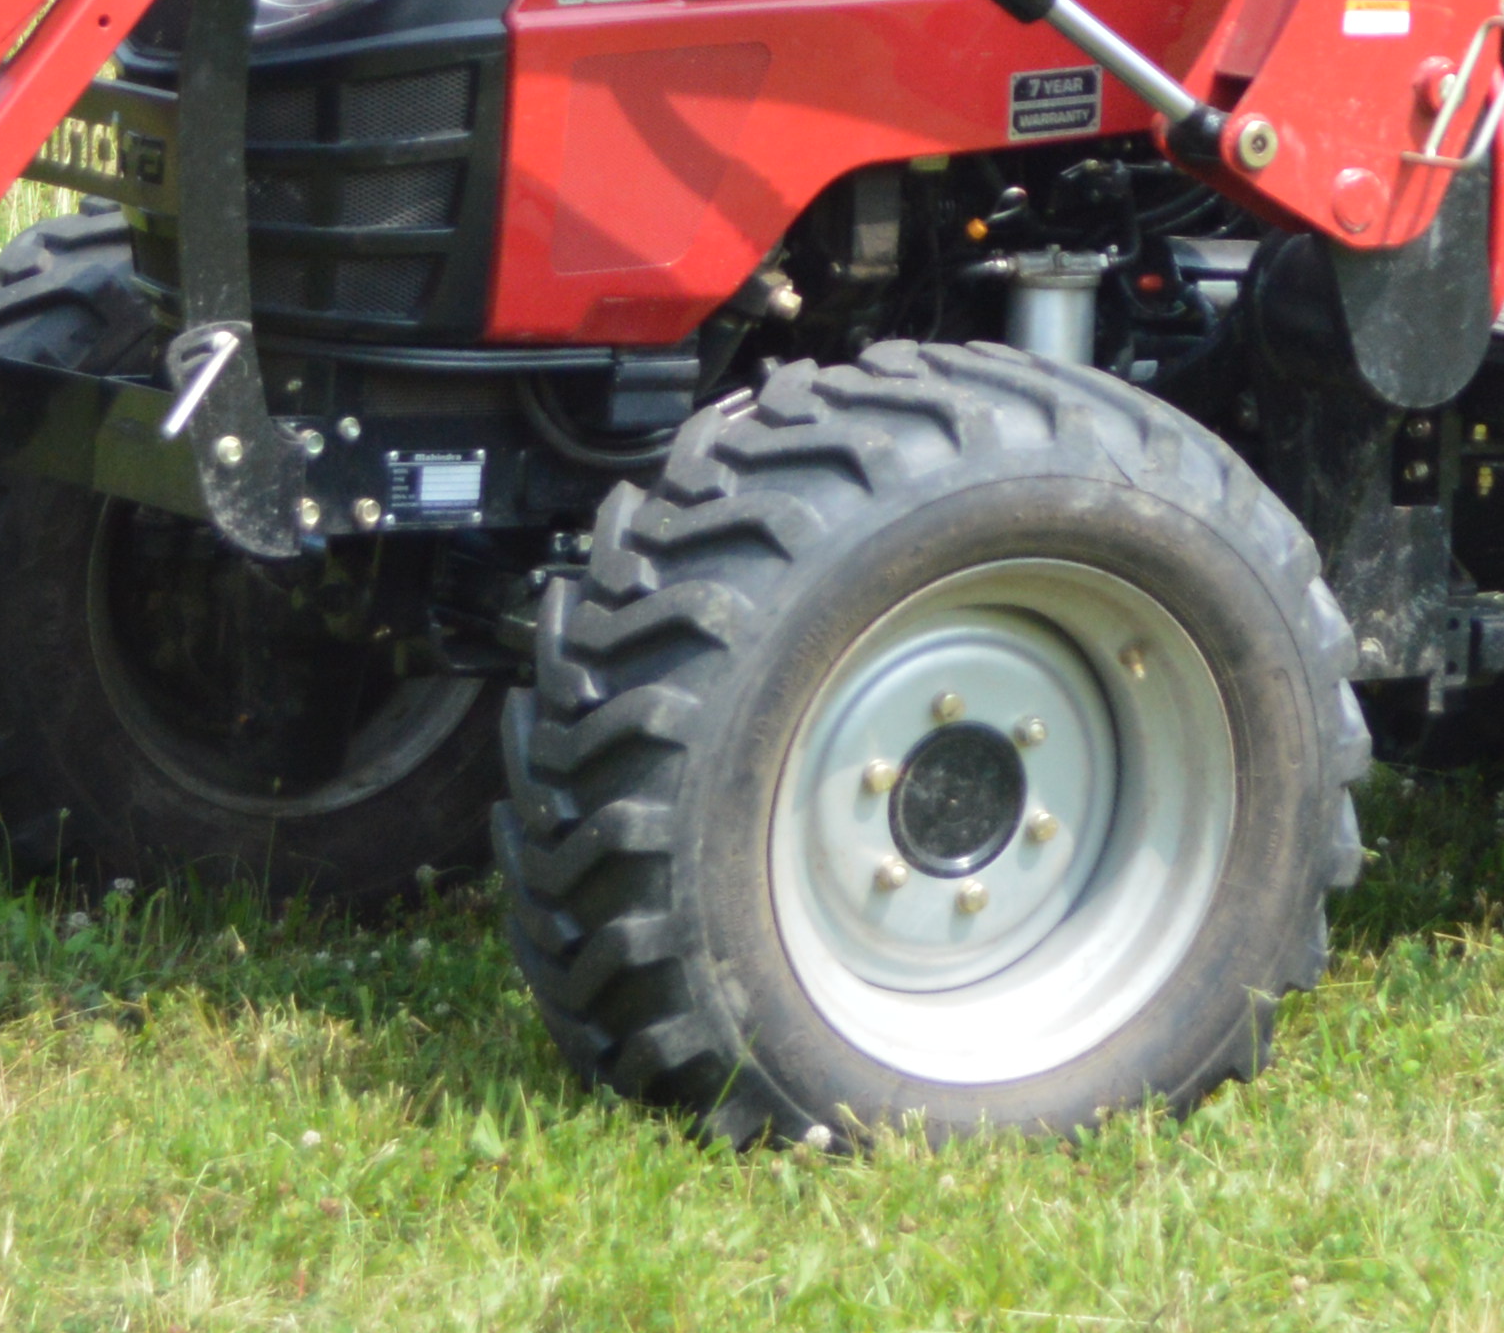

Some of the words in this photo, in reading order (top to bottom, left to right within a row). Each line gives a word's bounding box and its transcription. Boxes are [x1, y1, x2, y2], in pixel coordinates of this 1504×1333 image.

[1029, 78, 1041, 97] 7
[1043, 77, 1084, 95] YEAR
[1019, 108, 1091, 129] WARRANTY
